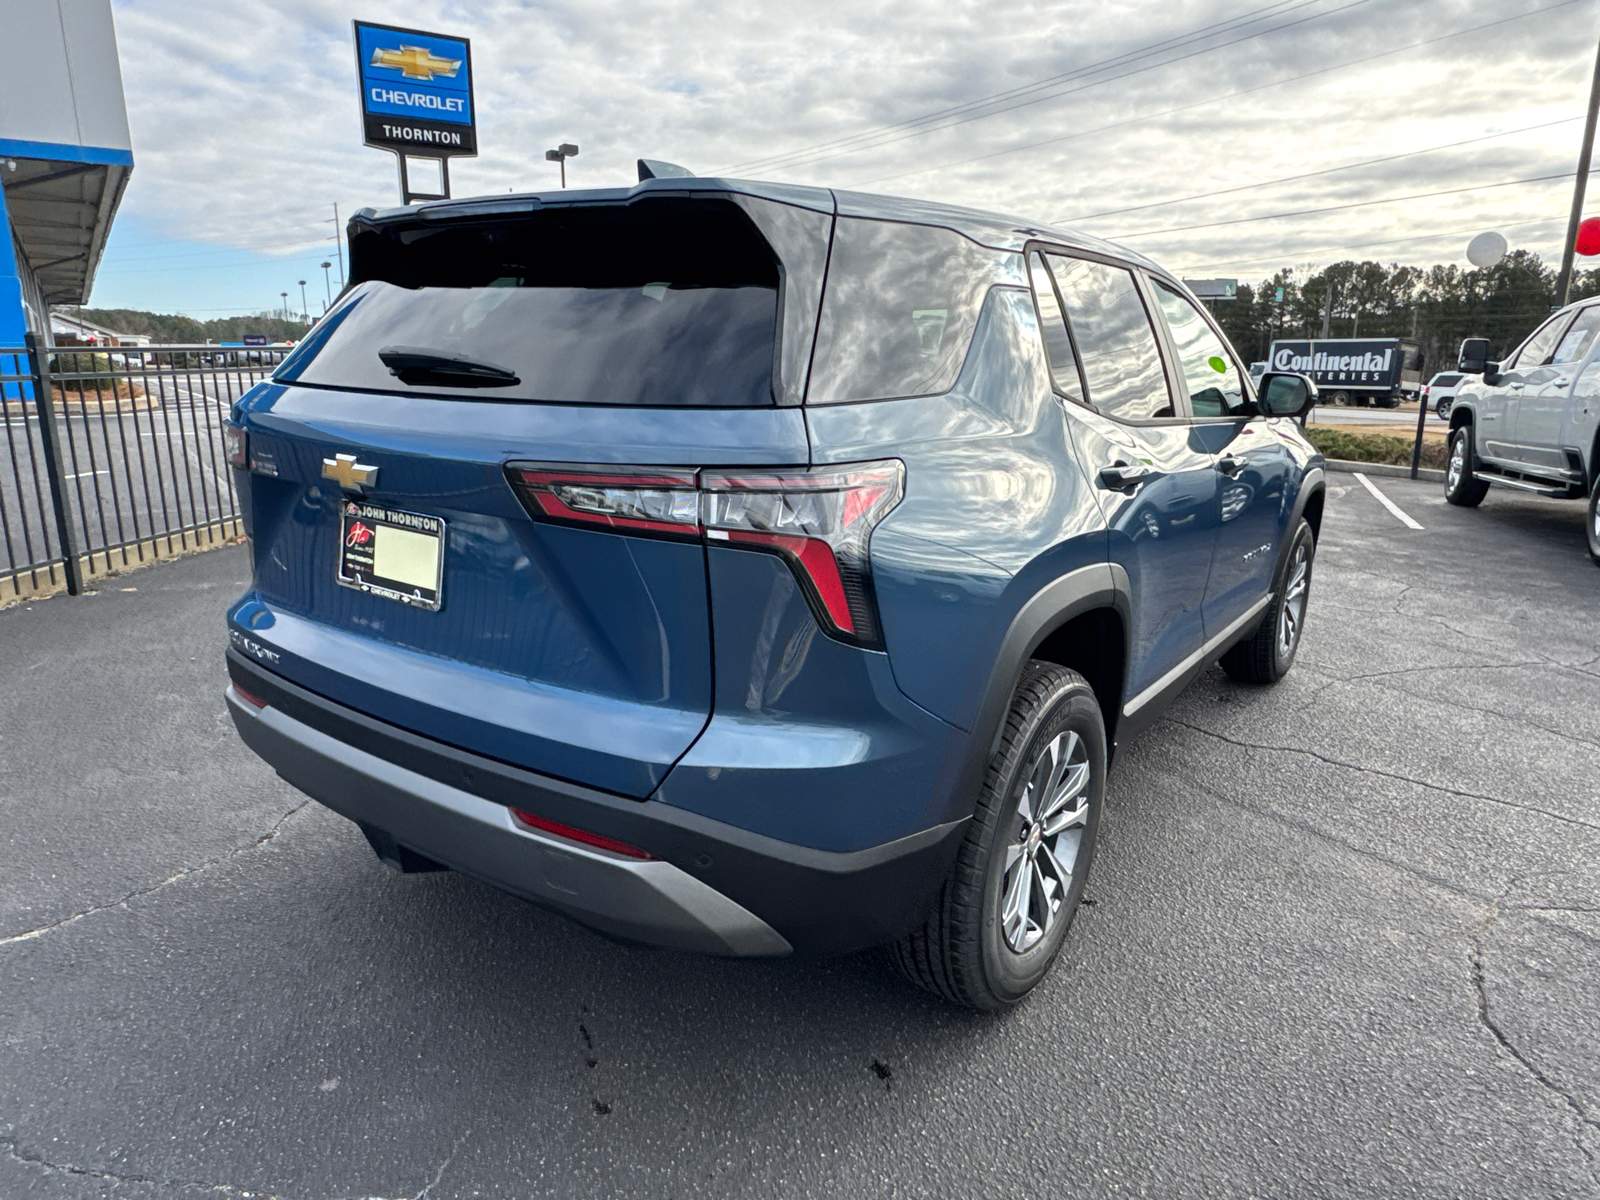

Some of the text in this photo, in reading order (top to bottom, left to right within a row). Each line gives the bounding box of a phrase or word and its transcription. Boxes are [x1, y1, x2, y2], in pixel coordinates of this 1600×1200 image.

[371, 88, 465, 112] CHEVROLET
[382, 125, 461, 145] THORNTON
[1274, 348, 1392, 372] Continental
[1296, 371, 1380, 380] TTERIES
[362, 505, 438, 532] JOHN THORNTON
